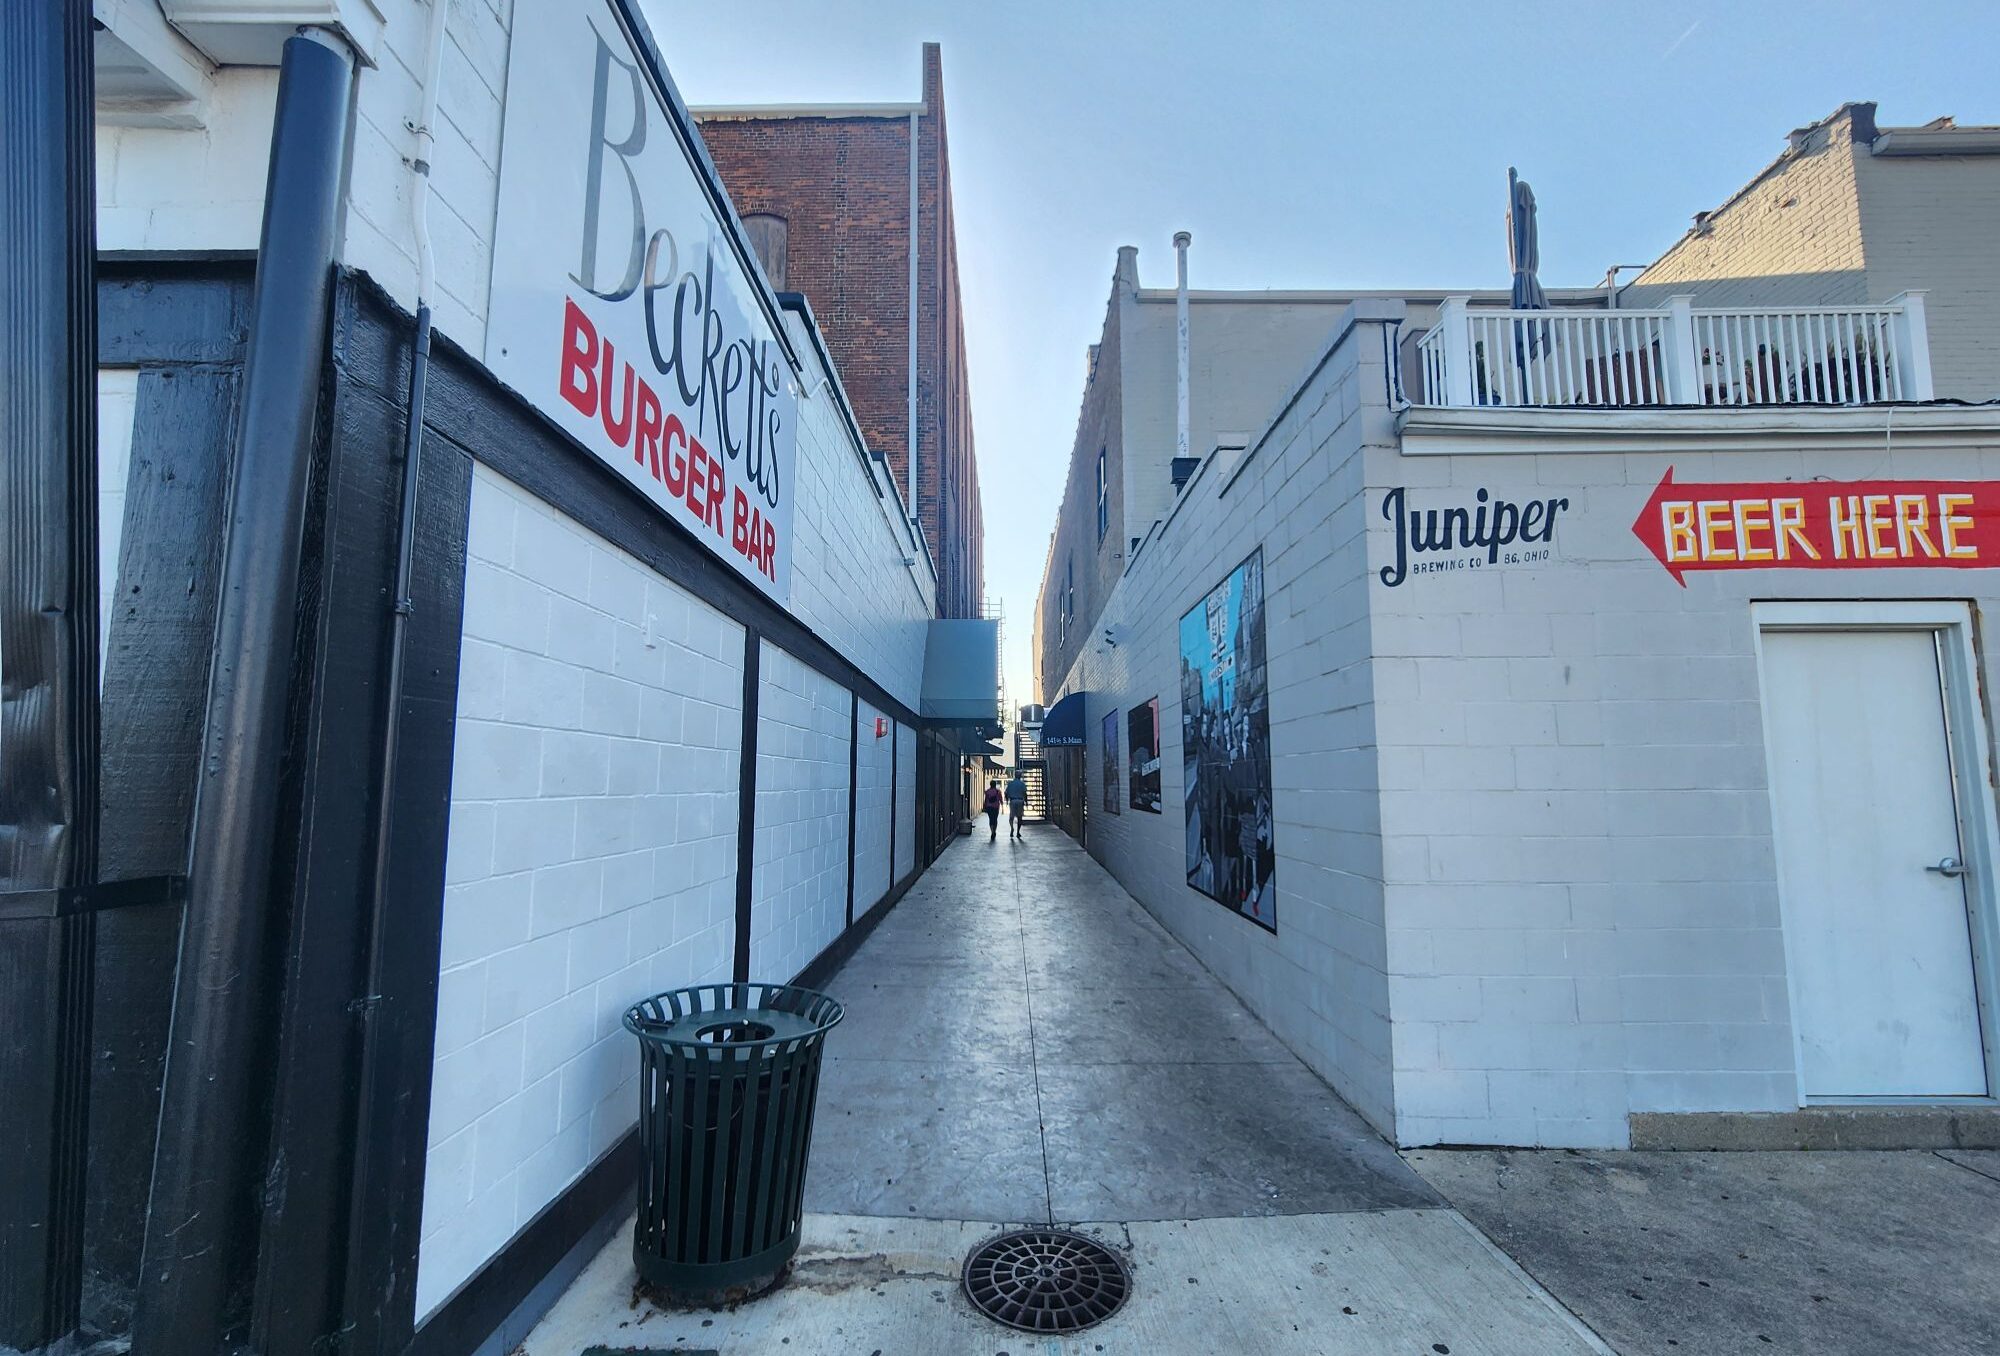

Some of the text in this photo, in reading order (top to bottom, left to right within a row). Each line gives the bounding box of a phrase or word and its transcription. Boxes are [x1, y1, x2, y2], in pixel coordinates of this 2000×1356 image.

[568, 14, 780, 508] Beckett's
[559, 295, 776, 584] BURGER BAR
[1380, 486, 1569, 587] Juniper
[1413, 550, 1549, 574] BREWING CO BG, OHIO
[1661, 493, 1978, 562] BEER HERE
